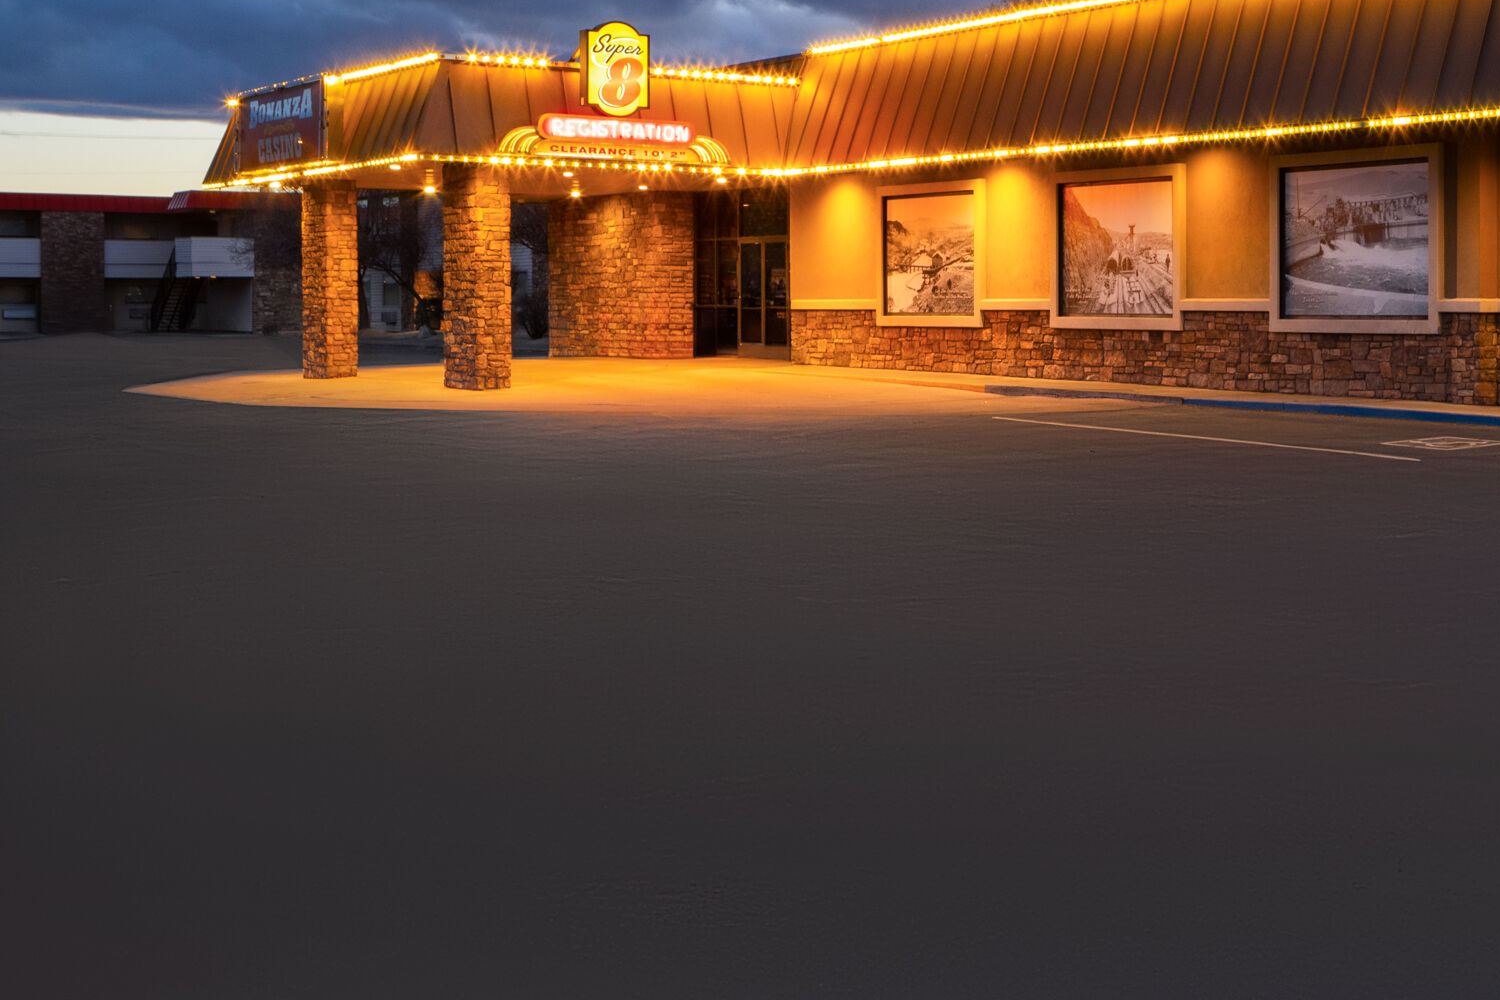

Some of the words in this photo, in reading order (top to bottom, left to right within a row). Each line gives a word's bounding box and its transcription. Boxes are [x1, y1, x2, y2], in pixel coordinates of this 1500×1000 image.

[592, 34, 644, 63] Super
[599, 57, 644, 108] 8
[249, 88, 313, 129] BONANZA
[550, 117, 690, 142] REGISTRATION
[257, 132, 303, 164] CASINO
[550, 145, 636, 156] CLEARANCE
